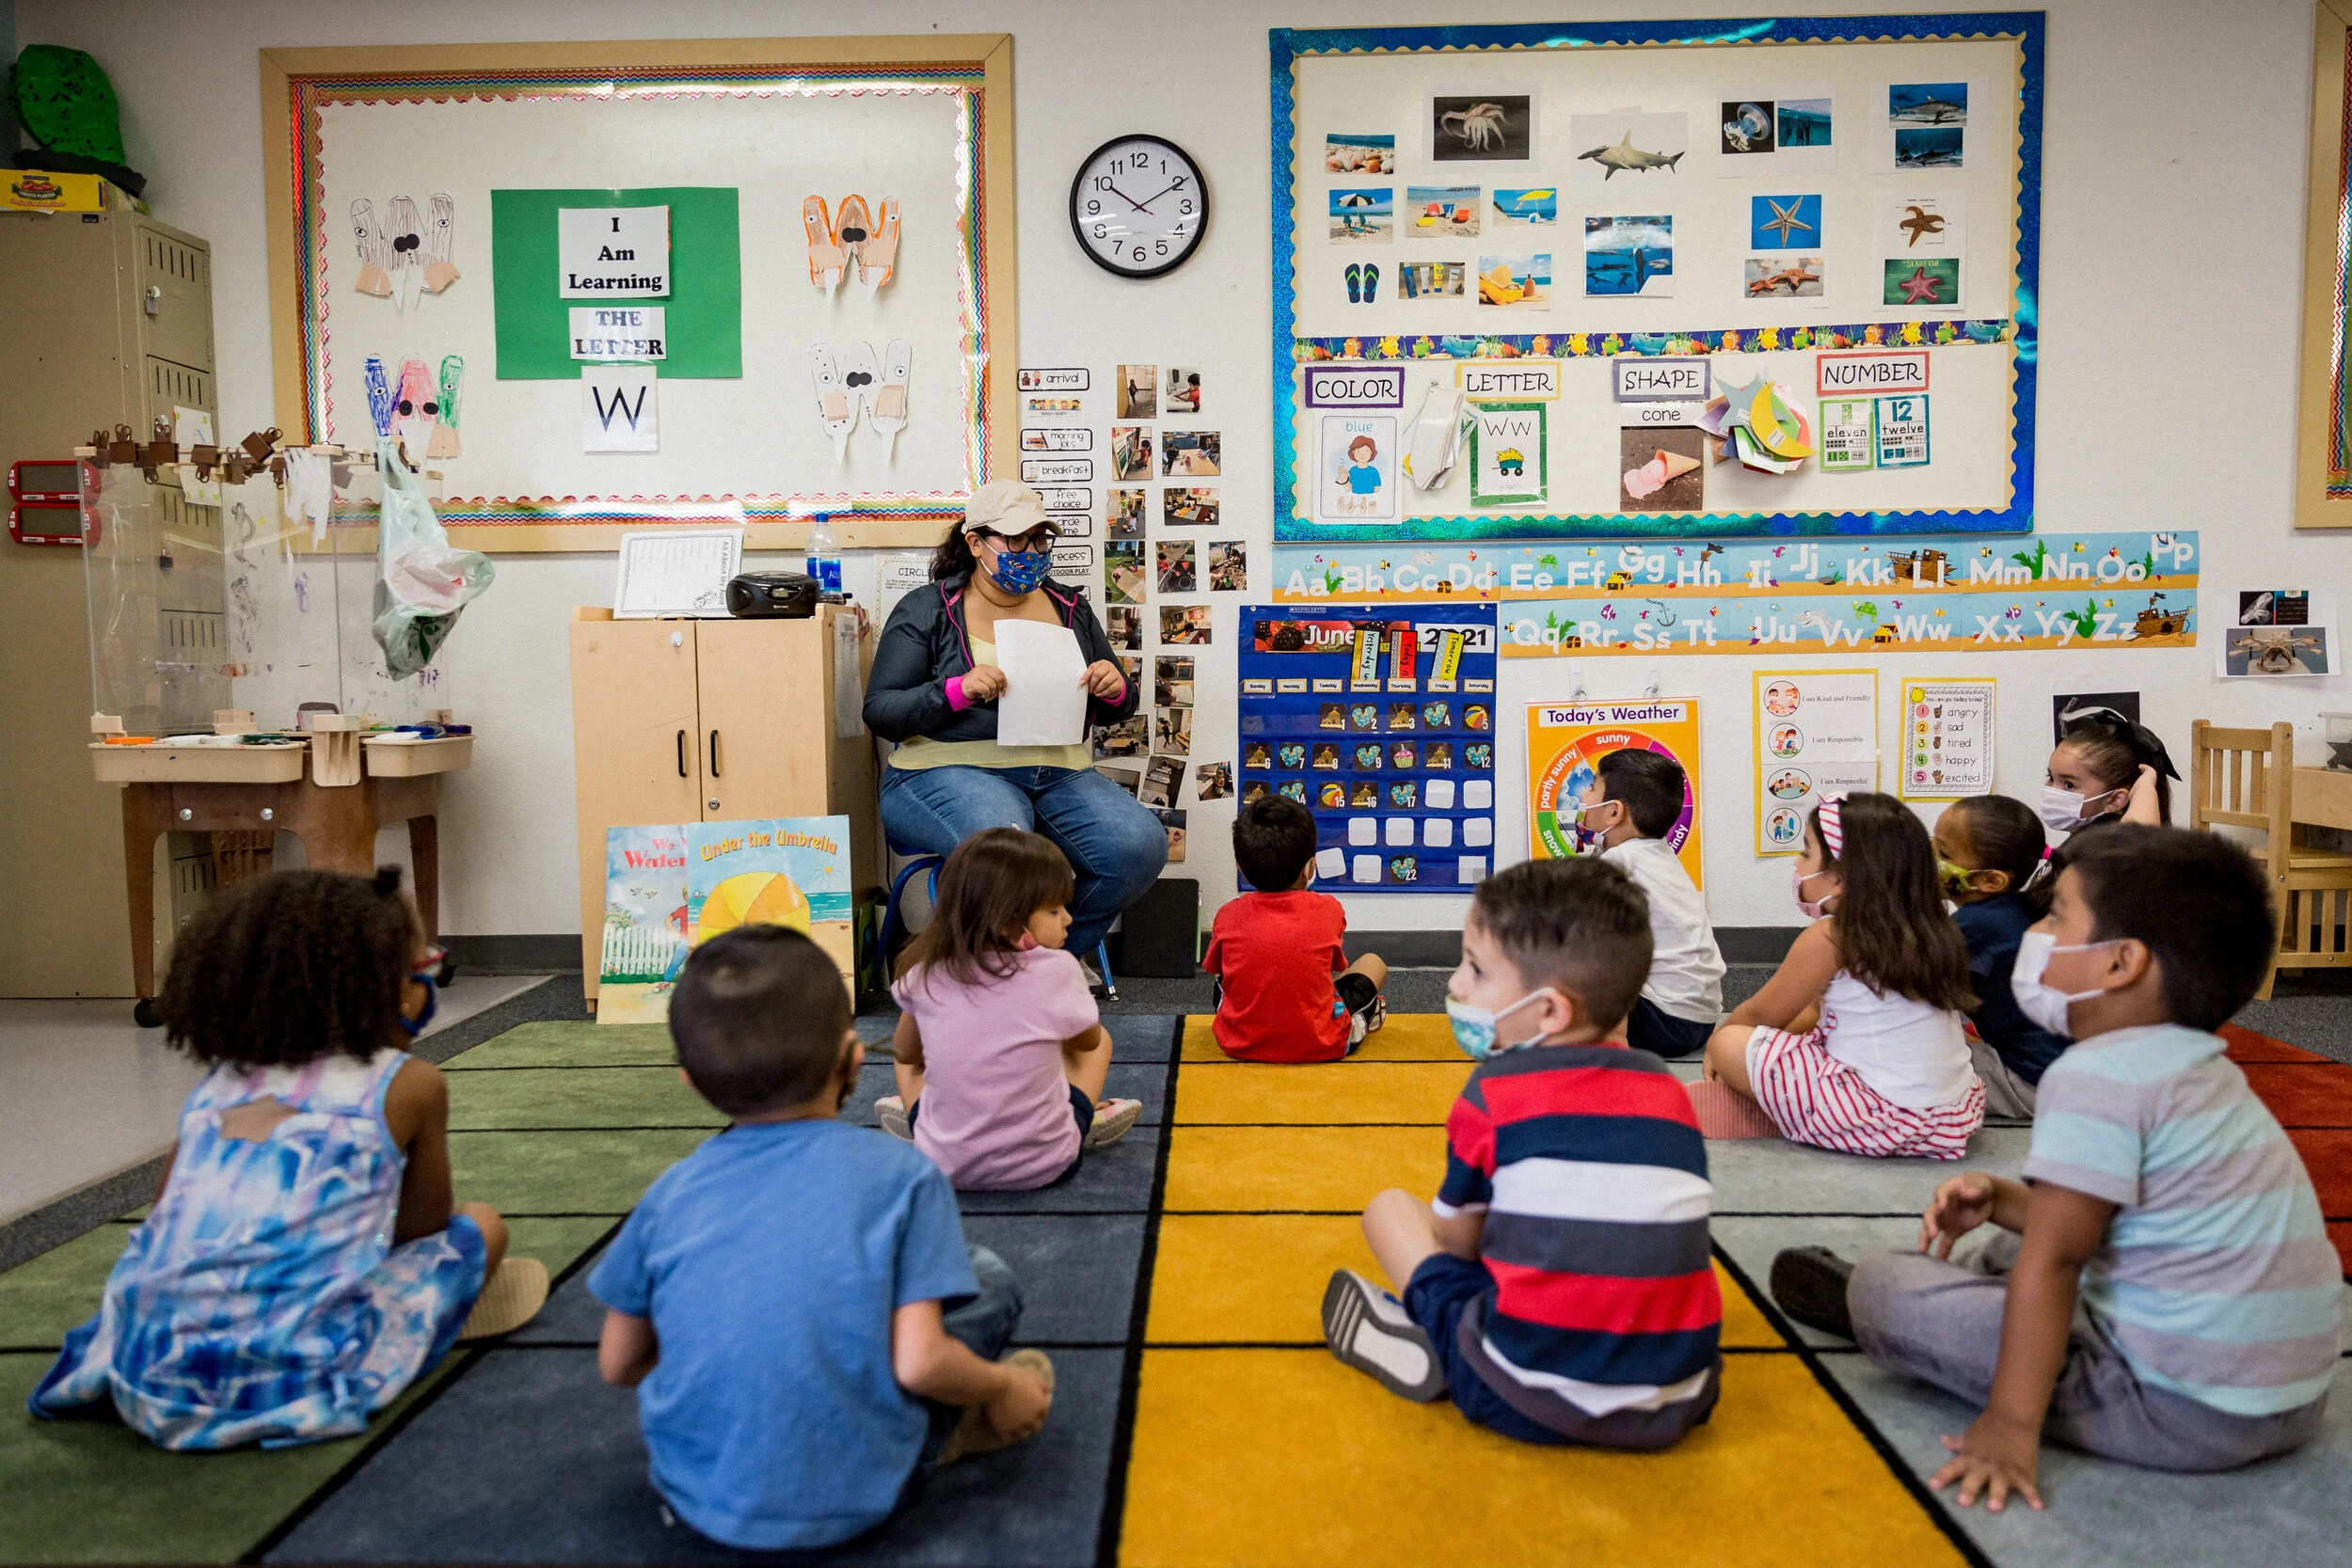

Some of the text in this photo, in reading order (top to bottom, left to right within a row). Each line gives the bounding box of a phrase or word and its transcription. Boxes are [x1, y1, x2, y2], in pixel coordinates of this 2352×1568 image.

[1129, 152, 1148, 167] 12
[1110, 160, 1122, 175] 11
[1160, 160, 1166, 175] 1
[1093, 176, 1113, 191] 10
[1172, 176, 1184, 191] 2
[1088, 199, 1101, 214] 9
[1180, 199, 1192, 214] 3
[612, 217, 620, 232] I
[1094, 224, 1106, 239] 8
[1172, 223, 1185, 239] 4
[596, 245, 635, 261] Am
[1112, 240, 1123, 255] 7
[1133, 246, 1146, 261] 6
[1155, 240, 1168, 255] 5
[568, 273, 662, 292] Learning
[595, 310, 642, 327] THE
[575, 339, 664, 356] LETTER
[1046, 372, 1079, 383] arrival
[1626, 370, 1699, 391] SHAPE
[1825, 363, 1922, 384] NUMBER
[1315, 380, 1397, 399] COLOR
[1464, 372, 1554, 393] LETTER
[592, 386, 647, 434] W
[1642, 410, 1681, 421] cone
[1891, 401, 1913, 422] 12
[1345, 420, 1374, 433] blue
[1827, 426, 1867, 437] eleven
[1882, 421, 1924, 436] twelve
[1051, 433, 1084, 442] morning
[1059, 440, 1076, 451] jobs
[1041, 464, 1089, 475] breakfast
[1057, 490, 1077, 499] free
[1063, 527, 1078, 535] ime
[1052, 551, 1087, 561] recess
[898, 567, 929, 577] CIRCL
[1283, 533, 2194, 597] Aa Bb Cc Dd Ee Ff Gg Hh Ii Jj Kk Ll Mm Nn Oo Pp
[1305, 625, 1355, 645] June
[1424, 628, 1486, 646] 221
[1511, 610, 2137, 655] Qq Rr Ss Tt Uu Vv Ww Xx Yy Zz
[1361, 633, 1375, 670] Yesterday
[1400, 643, 1413, 666] Today
[1444, 636, 1459, 674] Tomorrow
[1547, 705, 1679, 724] Today's Weather
[1947, 709, 1979, 719] angry
[1341, 715, 1488, 730] 1 2 3 4 5
[1947, 723, 1963, 732] sad
[1596, 734, 1630, 746] sunny
[1918, 738, 1972, 748] 3 tired
[1264, 756, 1490, 769] 6 7 8 9 11 12
[1946, 755, 1977, 767] happy
[1540, 747, 1578, 809] partly sunny
[1917, 771, 1980, 783] 5 excited
[1334, 796, 1345, 808] 15
[1367, 796, 1376, 807] 16
[1406, 796, 1416, 807] 17
[652, 837, 676, 850] We
[1668, 824, 1689, 848] indy
[700, 837, 743, 862] Under
[747, 831, 771, 847] the
[775, 830, 838, 855] Umbrella
[1405, 869, 1417, 880] 22
